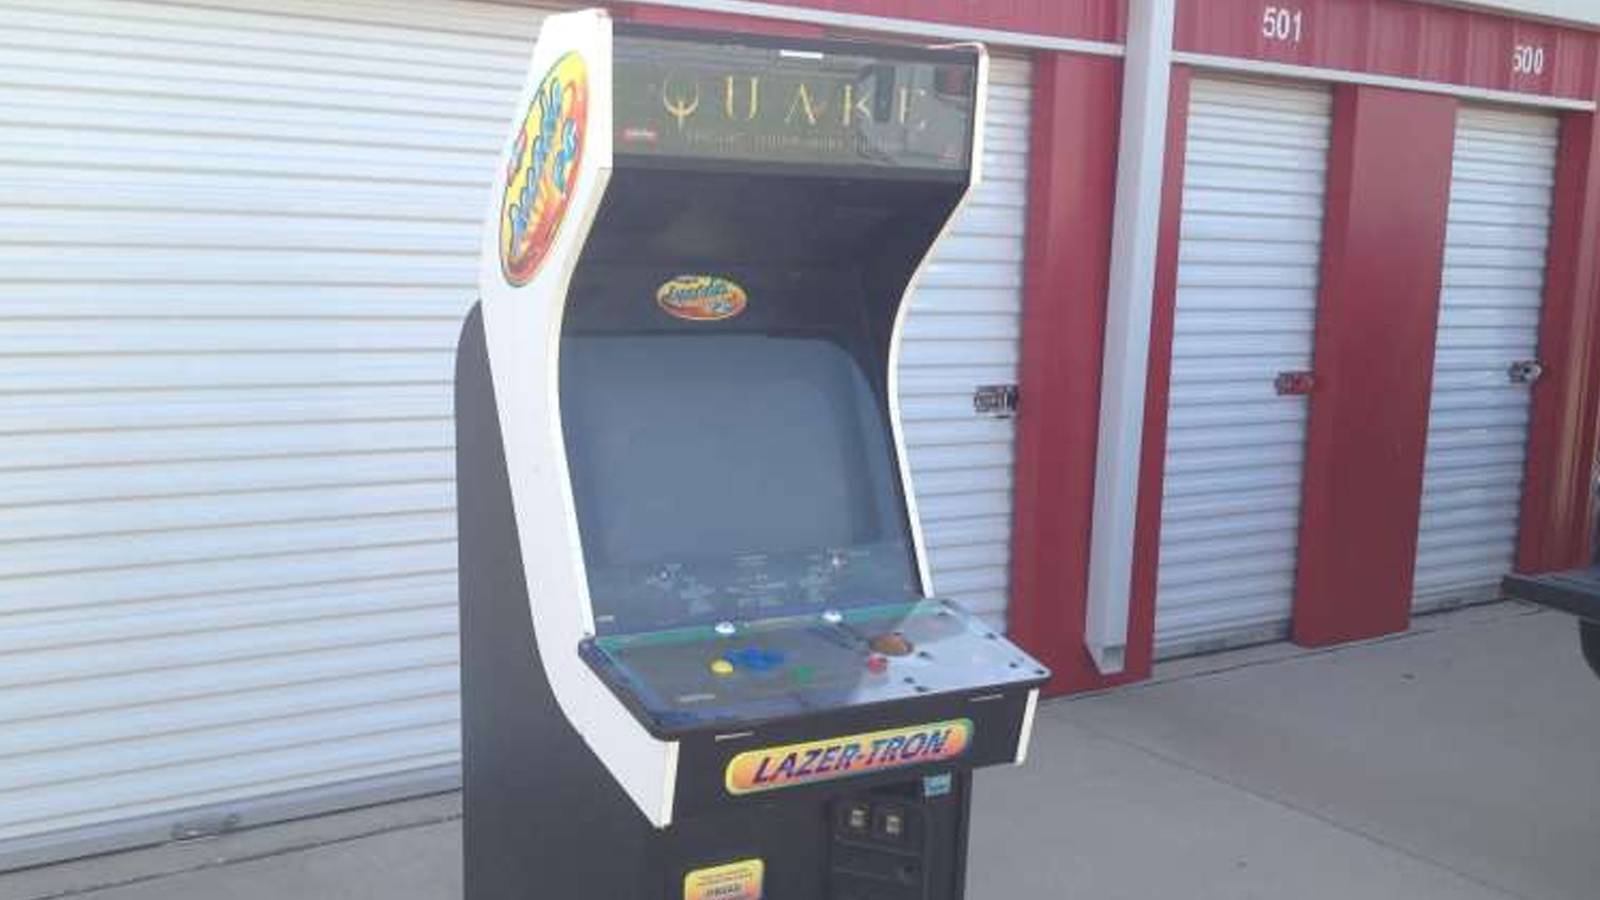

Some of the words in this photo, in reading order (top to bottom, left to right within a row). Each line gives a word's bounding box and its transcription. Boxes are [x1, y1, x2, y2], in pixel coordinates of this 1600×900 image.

[1262, 7, 1302, 42] 501
[1513, 46, 1544, 75] 500
[662, 71, 928, 131] QUAKE
[752, 729, 953, 784] LAZER-TRON
